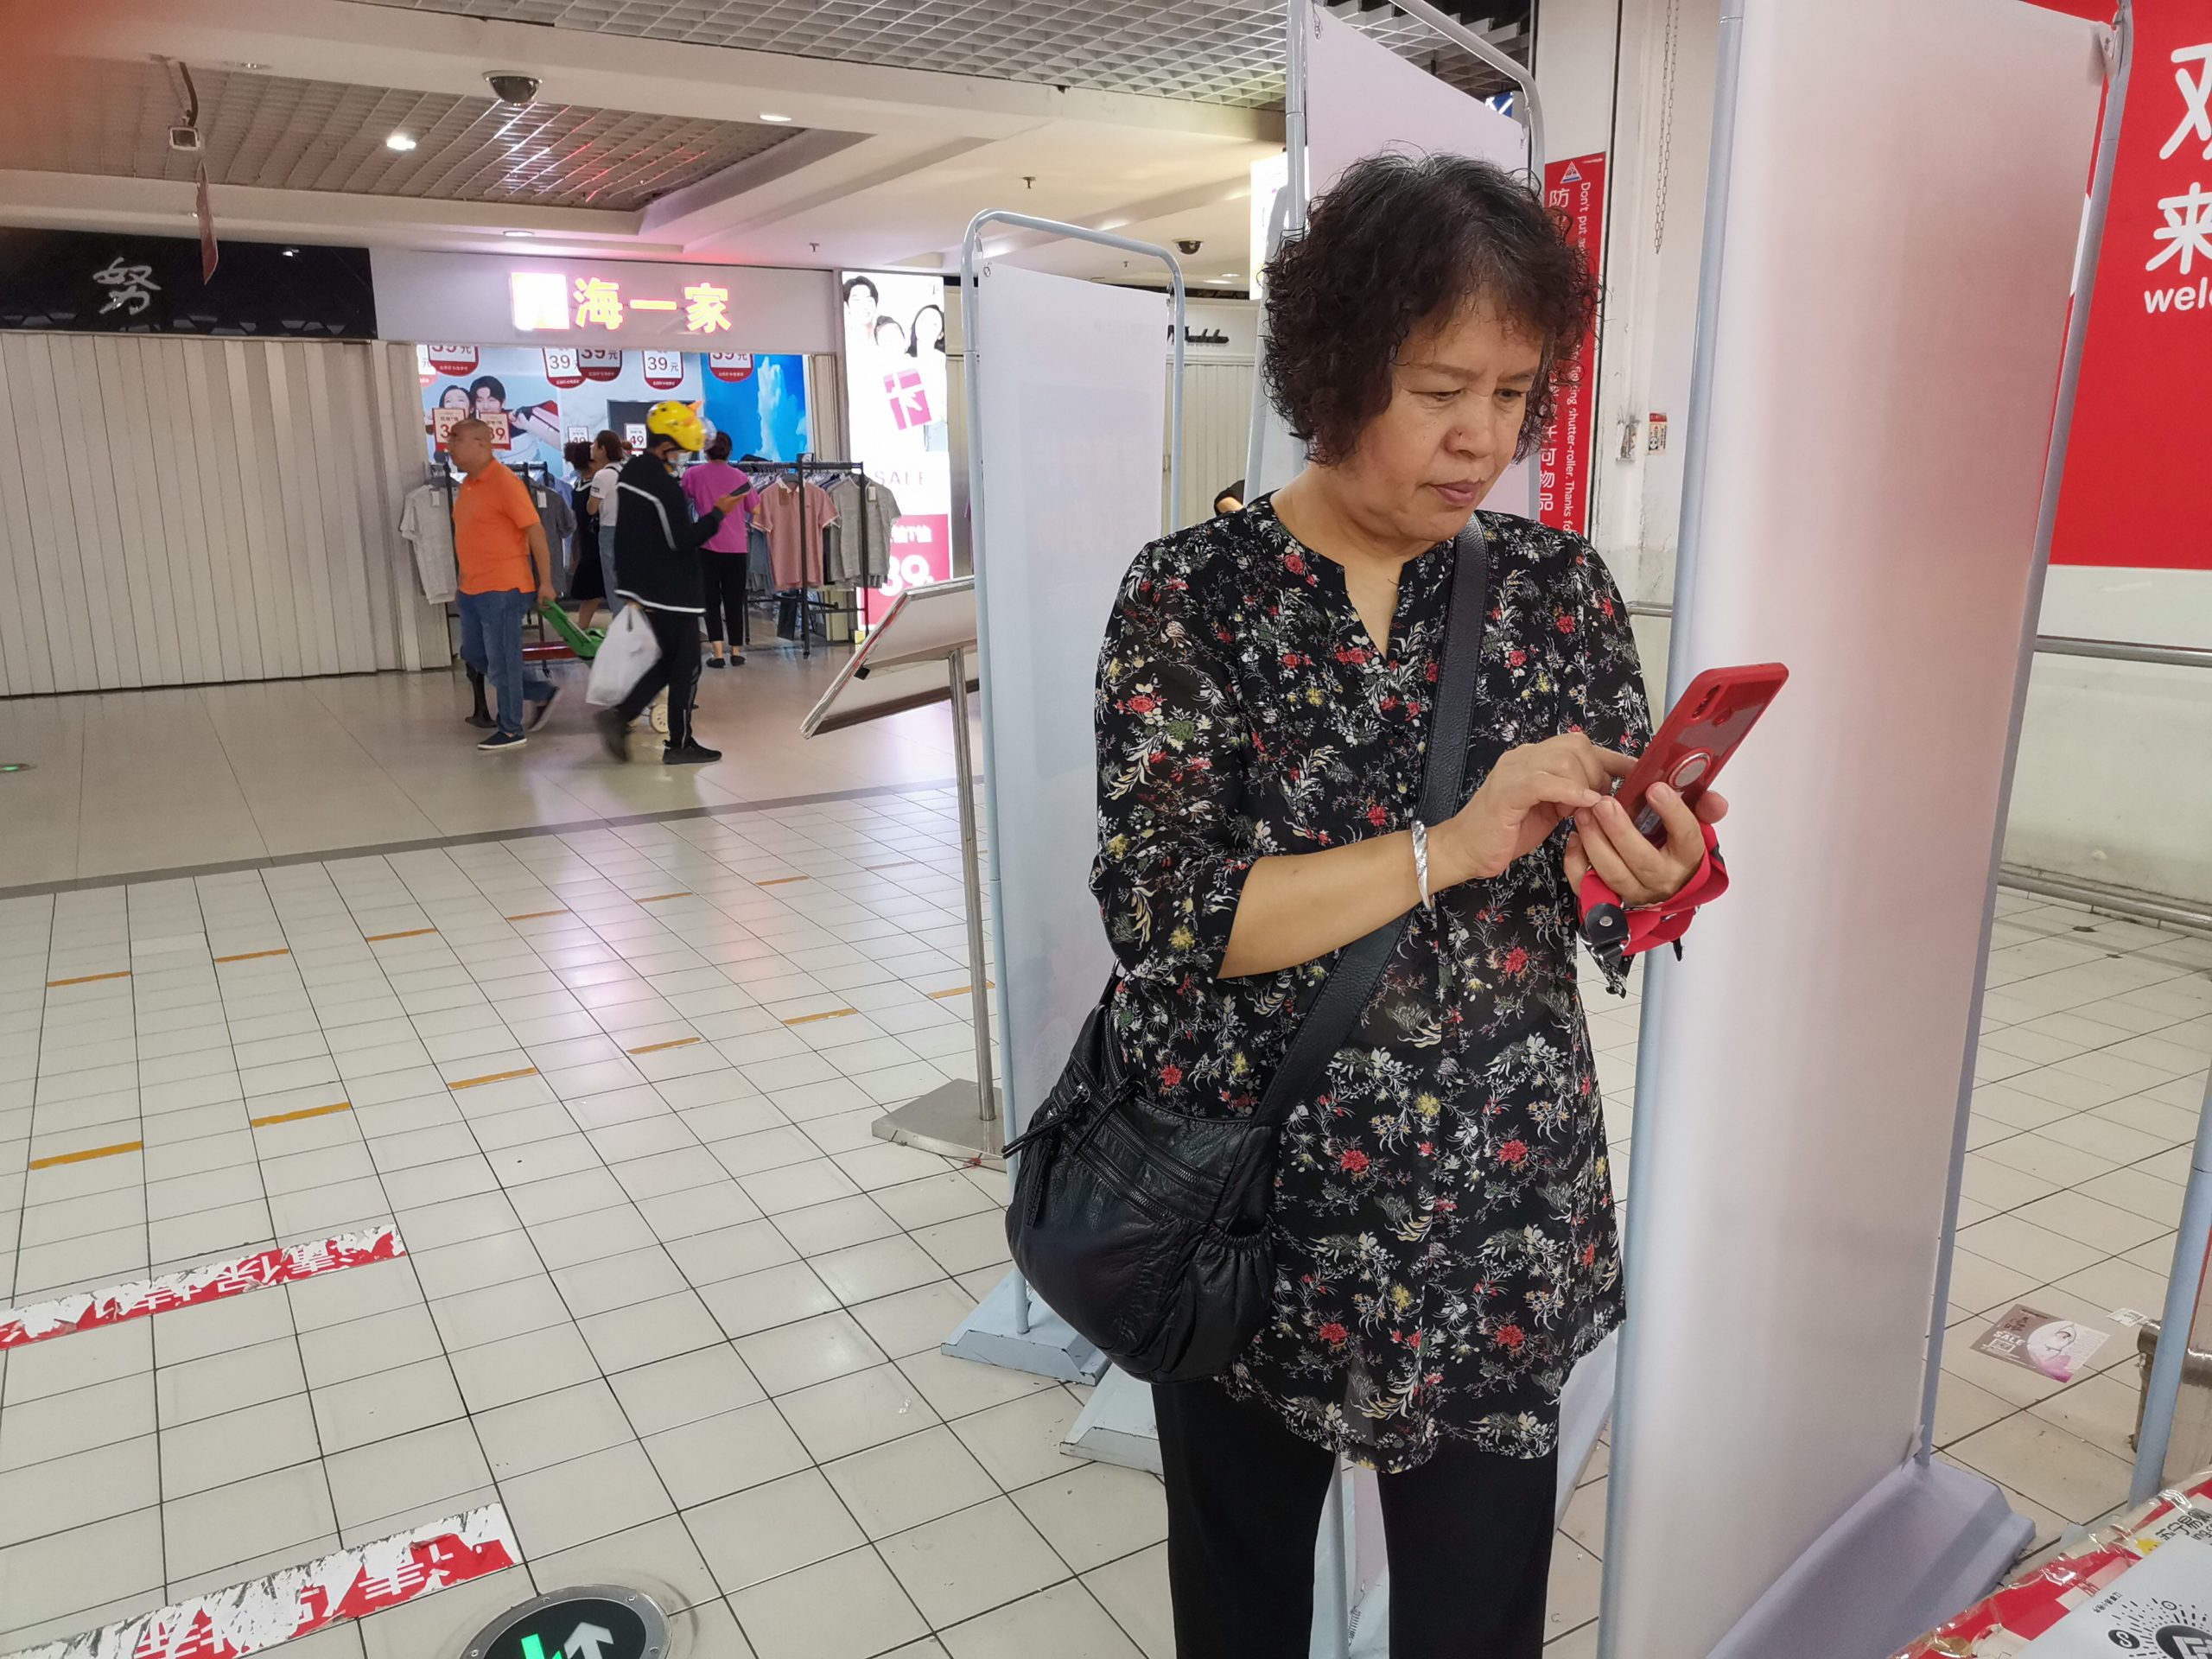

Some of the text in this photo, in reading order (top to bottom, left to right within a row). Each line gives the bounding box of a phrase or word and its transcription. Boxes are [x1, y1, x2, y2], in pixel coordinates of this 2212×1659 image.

[1580, 182, 1591, 213] Don't
[1578, 216, 1588, 235] put
[92, 257, 162, 315] 努
[2144, 276, 2212, 315] wel
[573, 276, 732, 334] 海一家
[1564, 481, 1576, 518] Thanks
[1993, 1331, 2026, 1346] SALE
